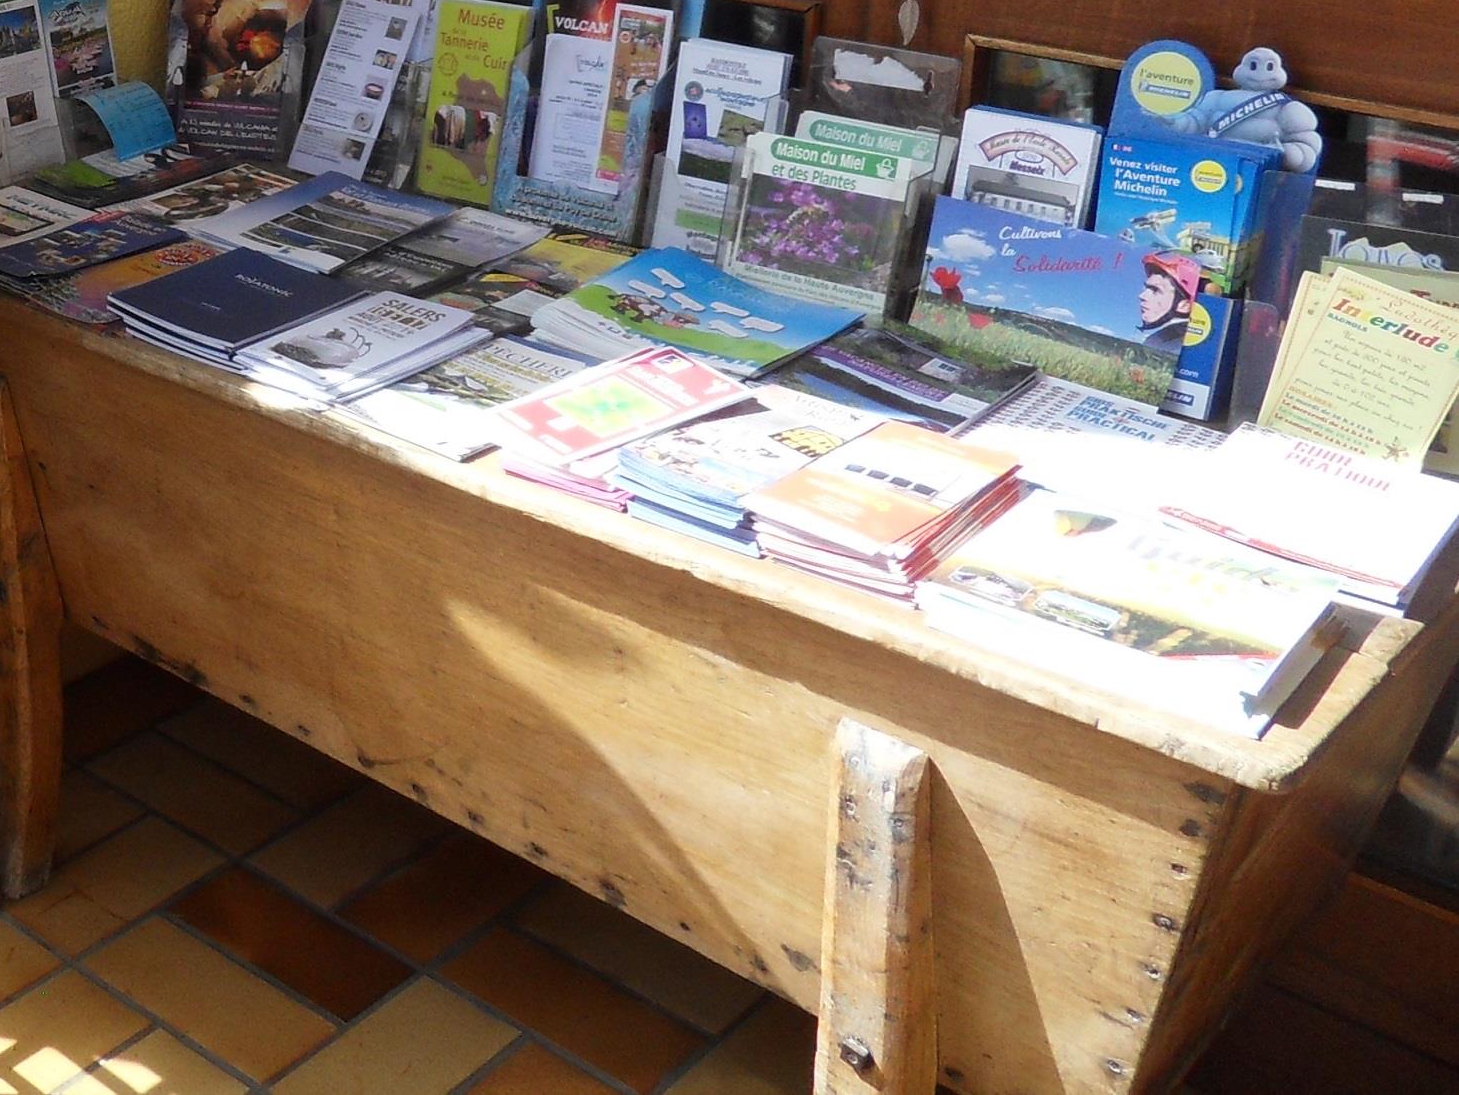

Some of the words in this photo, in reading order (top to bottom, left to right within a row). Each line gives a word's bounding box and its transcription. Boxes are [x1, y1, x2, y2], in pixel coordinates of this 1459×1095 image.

[457, 9, 506, 31] Musée
[554, 15, 609, 33] VOLCAN
[440, 32, 489, 52] Tannerie
[483, 54, 508, 70] Cuir
[1140, 68, 1194, 86] l'aventure
[1218, 93, 1286, 130] MICHELIN
[816, 123, 855, 144] Maison
[859, 131, 874, 146] du
[877, 136, 902, 152] Miel
[776, 142, 819, 162] Maison
[821, 149, 837, 165] du
[841, 154, 866, 171] Miel
[1109, 157, 1141, 169] Venez
[1145, 162, 1178, 175] visiter
[772, 163, 786, 175] et
[787, 165, 808, 182] des
[812, 171, 857, 191] Plantes
[1115, 168, 1181, 186] l'Aventure
[1114, 181, 1168, 197] Michelin
[998, 225, 1062, 242] Cultivons
[1000, 244, 1016, 257] la
[382, 299, 445, 323] SALERS
